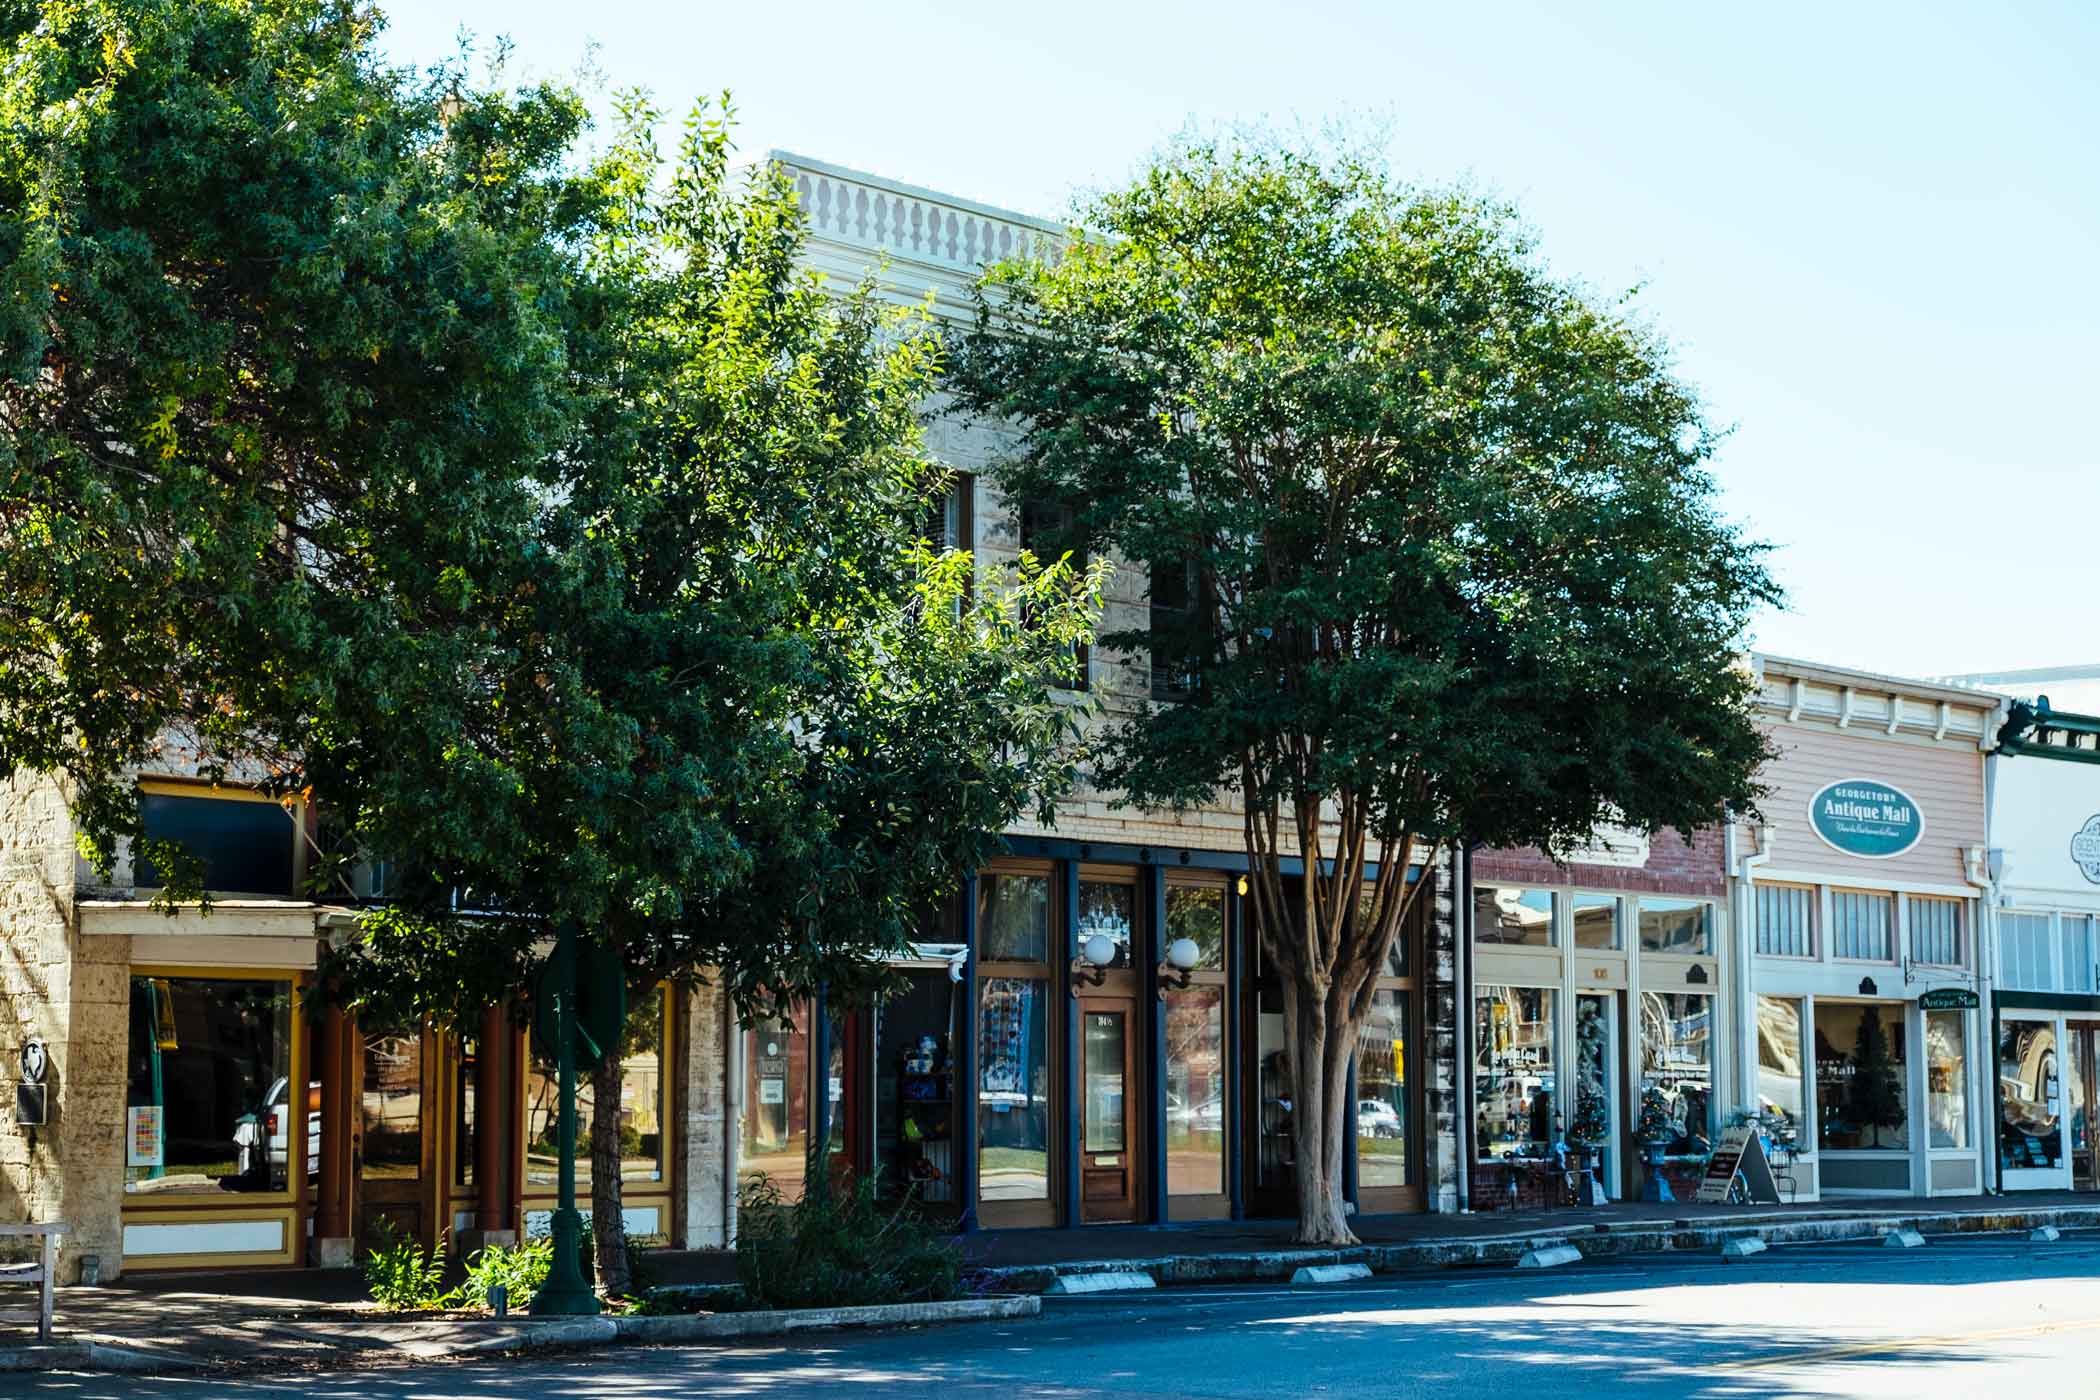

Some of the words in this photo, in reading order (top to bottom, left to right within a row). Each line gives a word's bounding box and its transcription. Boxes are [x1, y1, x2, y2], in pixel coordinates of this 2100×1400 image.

[1835, 788, 1896, 802] GEORGETOWN
[1824, 799, 1880, 821] Antique
[1882, 805, 1910, 823] Mall
[1827, 1066, 1856, 1075] Mall
